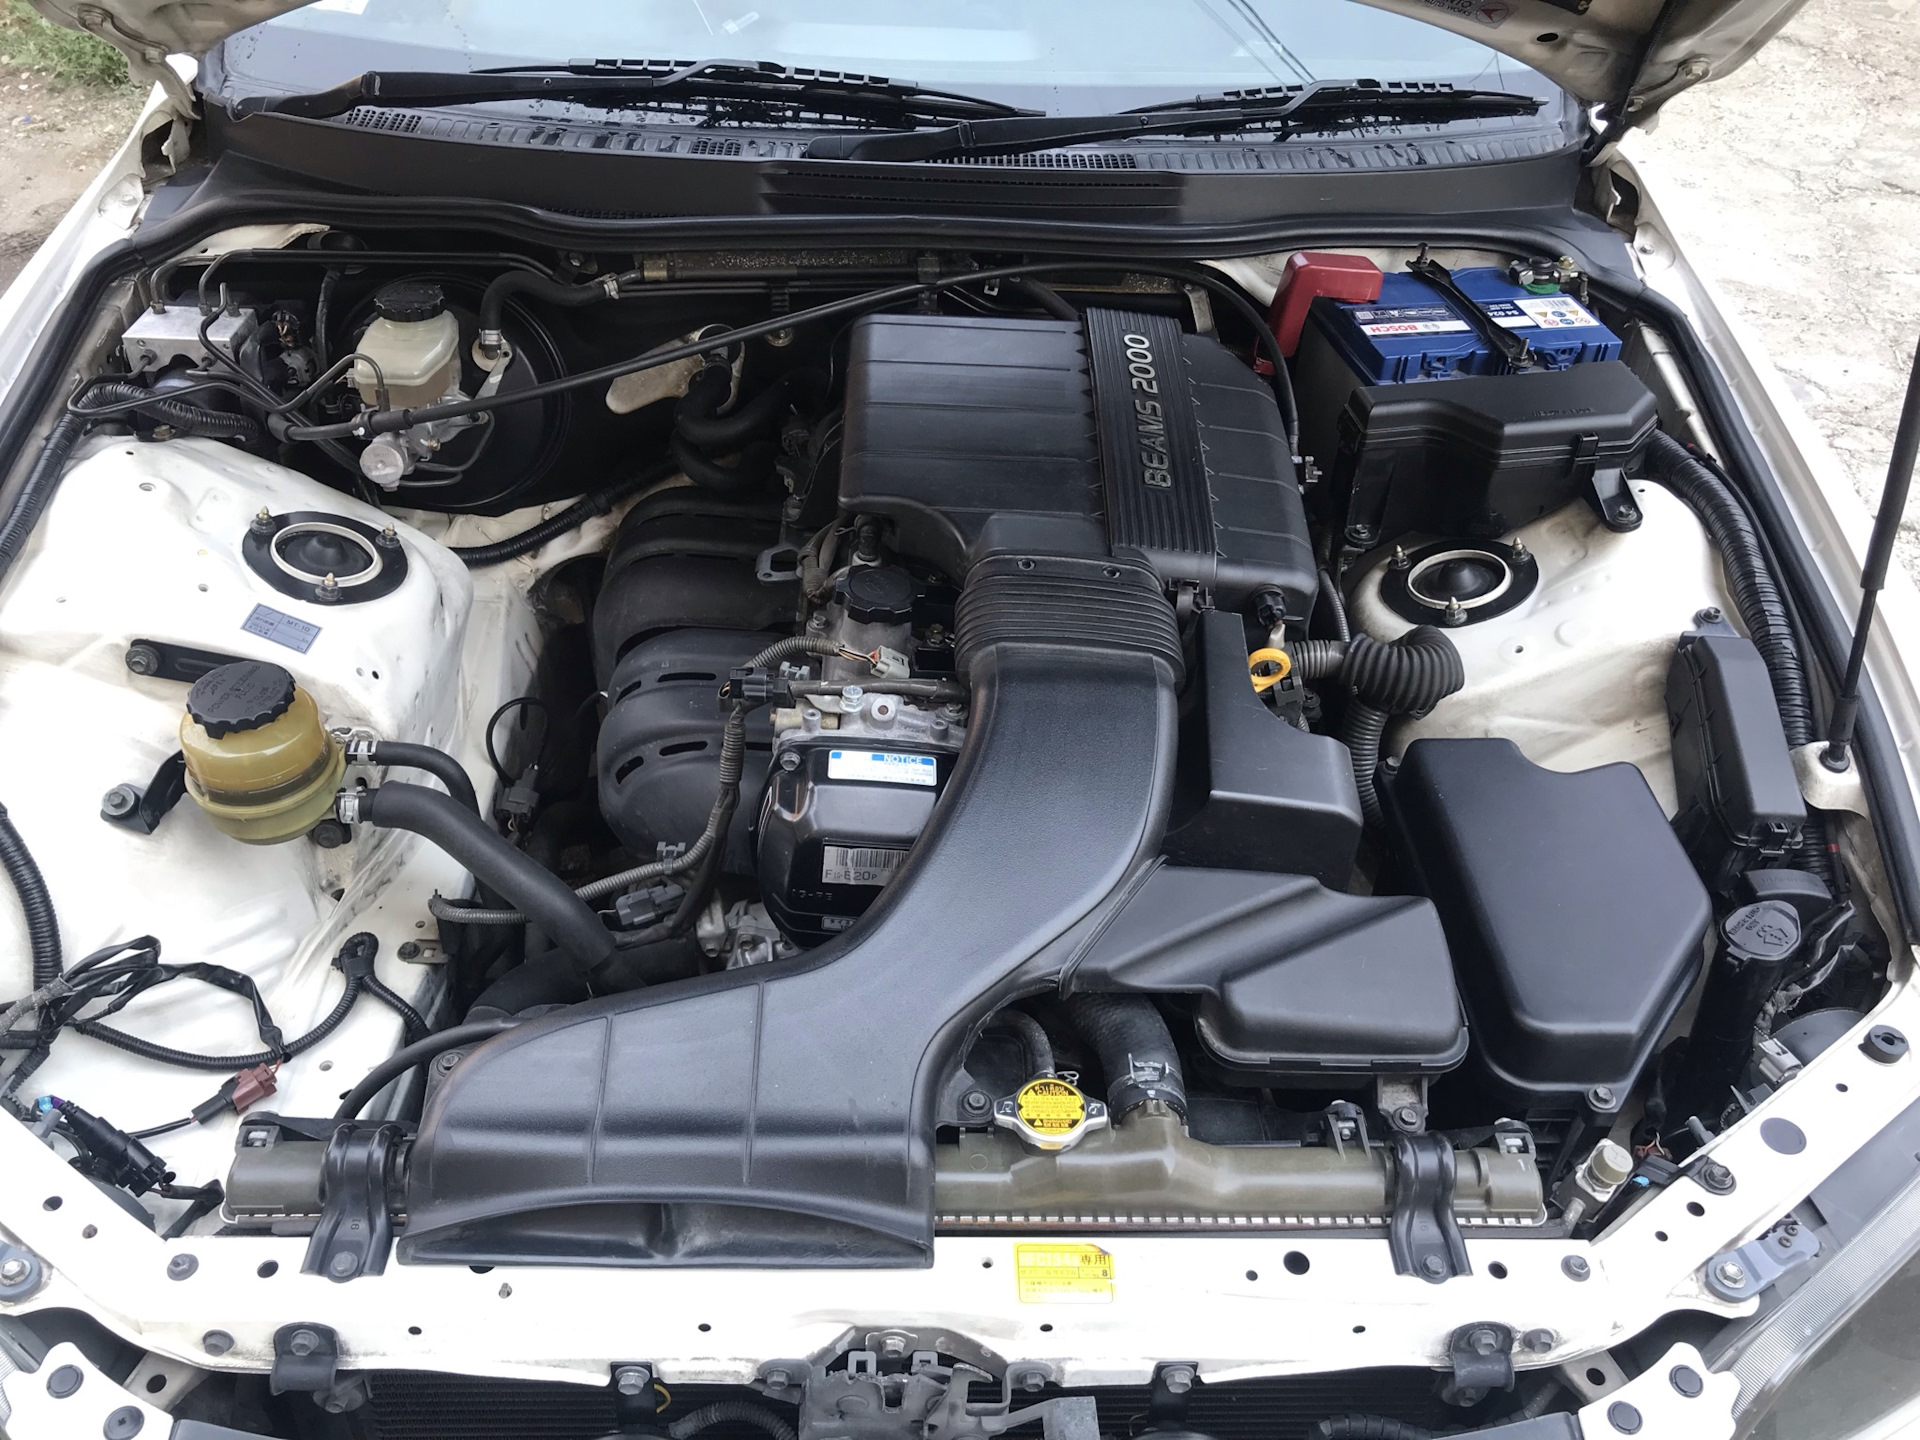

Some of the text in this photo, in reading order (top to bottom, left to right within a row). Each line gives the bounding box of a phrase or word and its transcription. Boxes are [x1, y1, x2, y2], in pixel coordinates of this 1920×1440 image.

[1370, 324, 1418, 333] BOSCH
[1123, 334, 1172, 488] BEAMS 2000
[286, 619, 311, 633] MT-10
[884, 754, 922, 765] NOTICE
